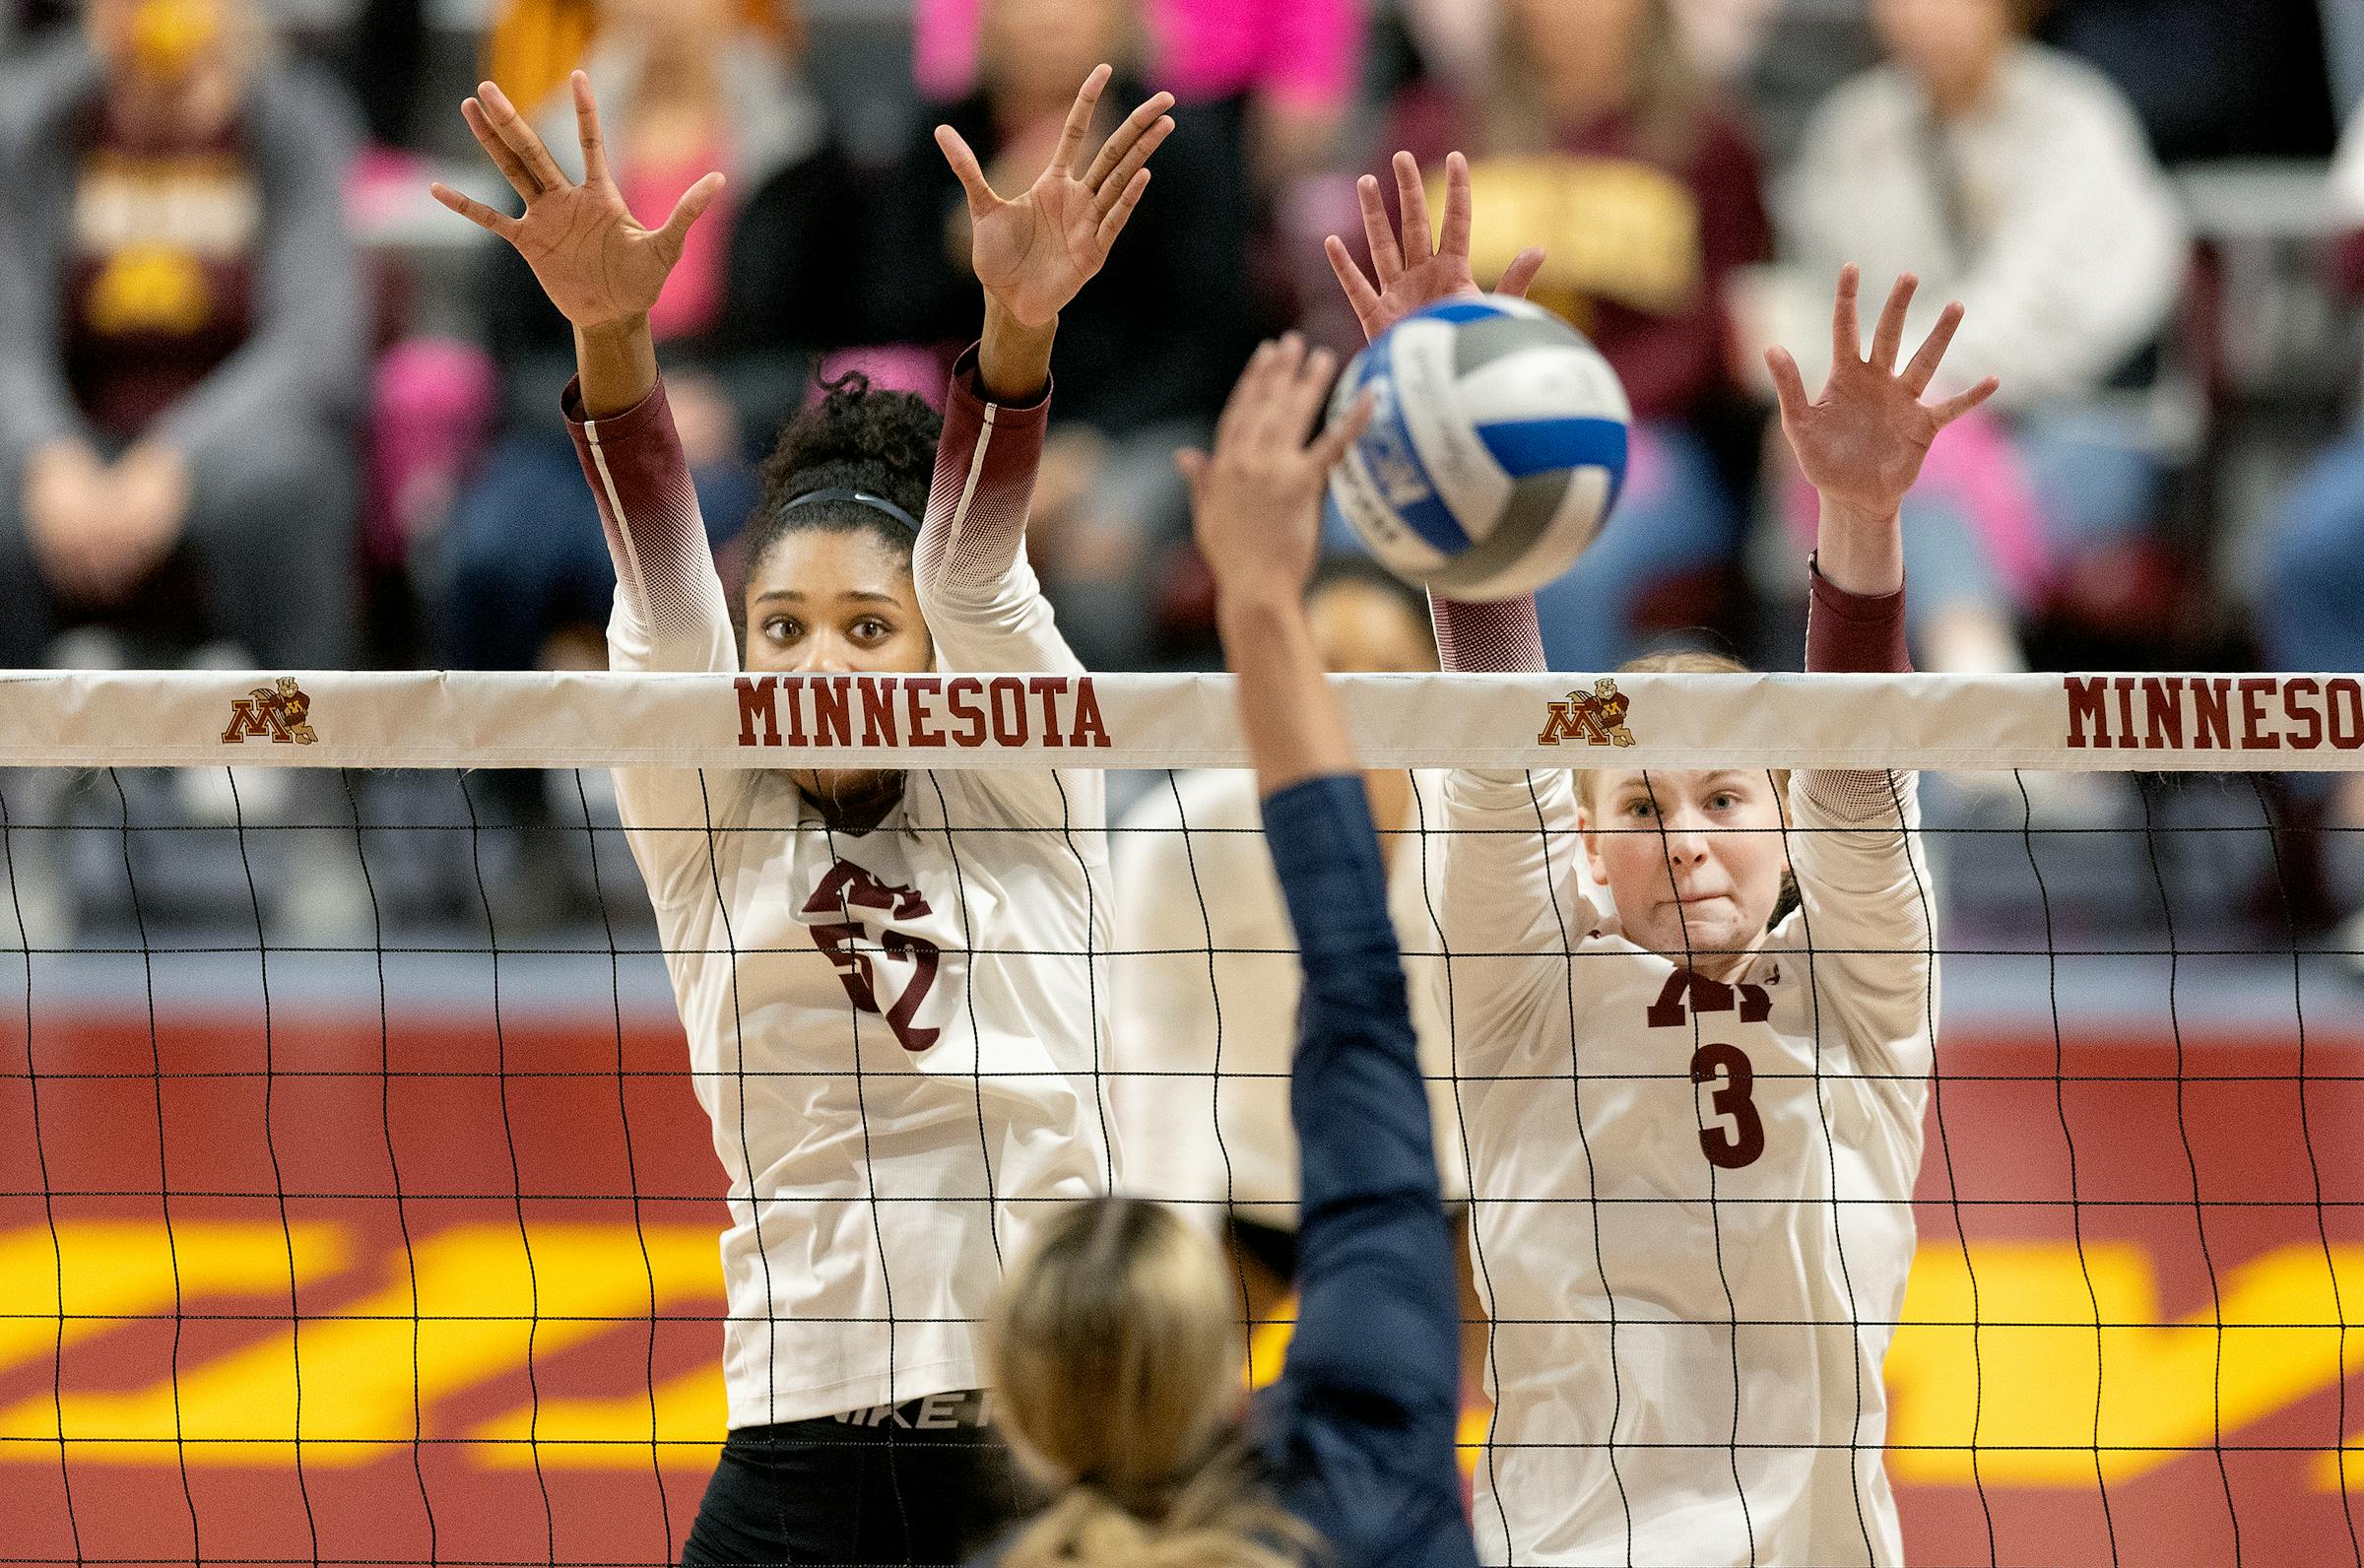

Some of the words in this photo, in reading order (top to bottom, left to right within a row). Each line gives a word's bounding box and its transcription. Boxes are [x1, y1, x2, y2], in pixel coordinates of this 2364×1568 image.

[734, 677, 1112, 748] MINNESOTA
[2064, 677, 2364, 750] MINNESO
[809, 921, 941, 1052] 52
[1690, 1043, 1765, 1169] 3
